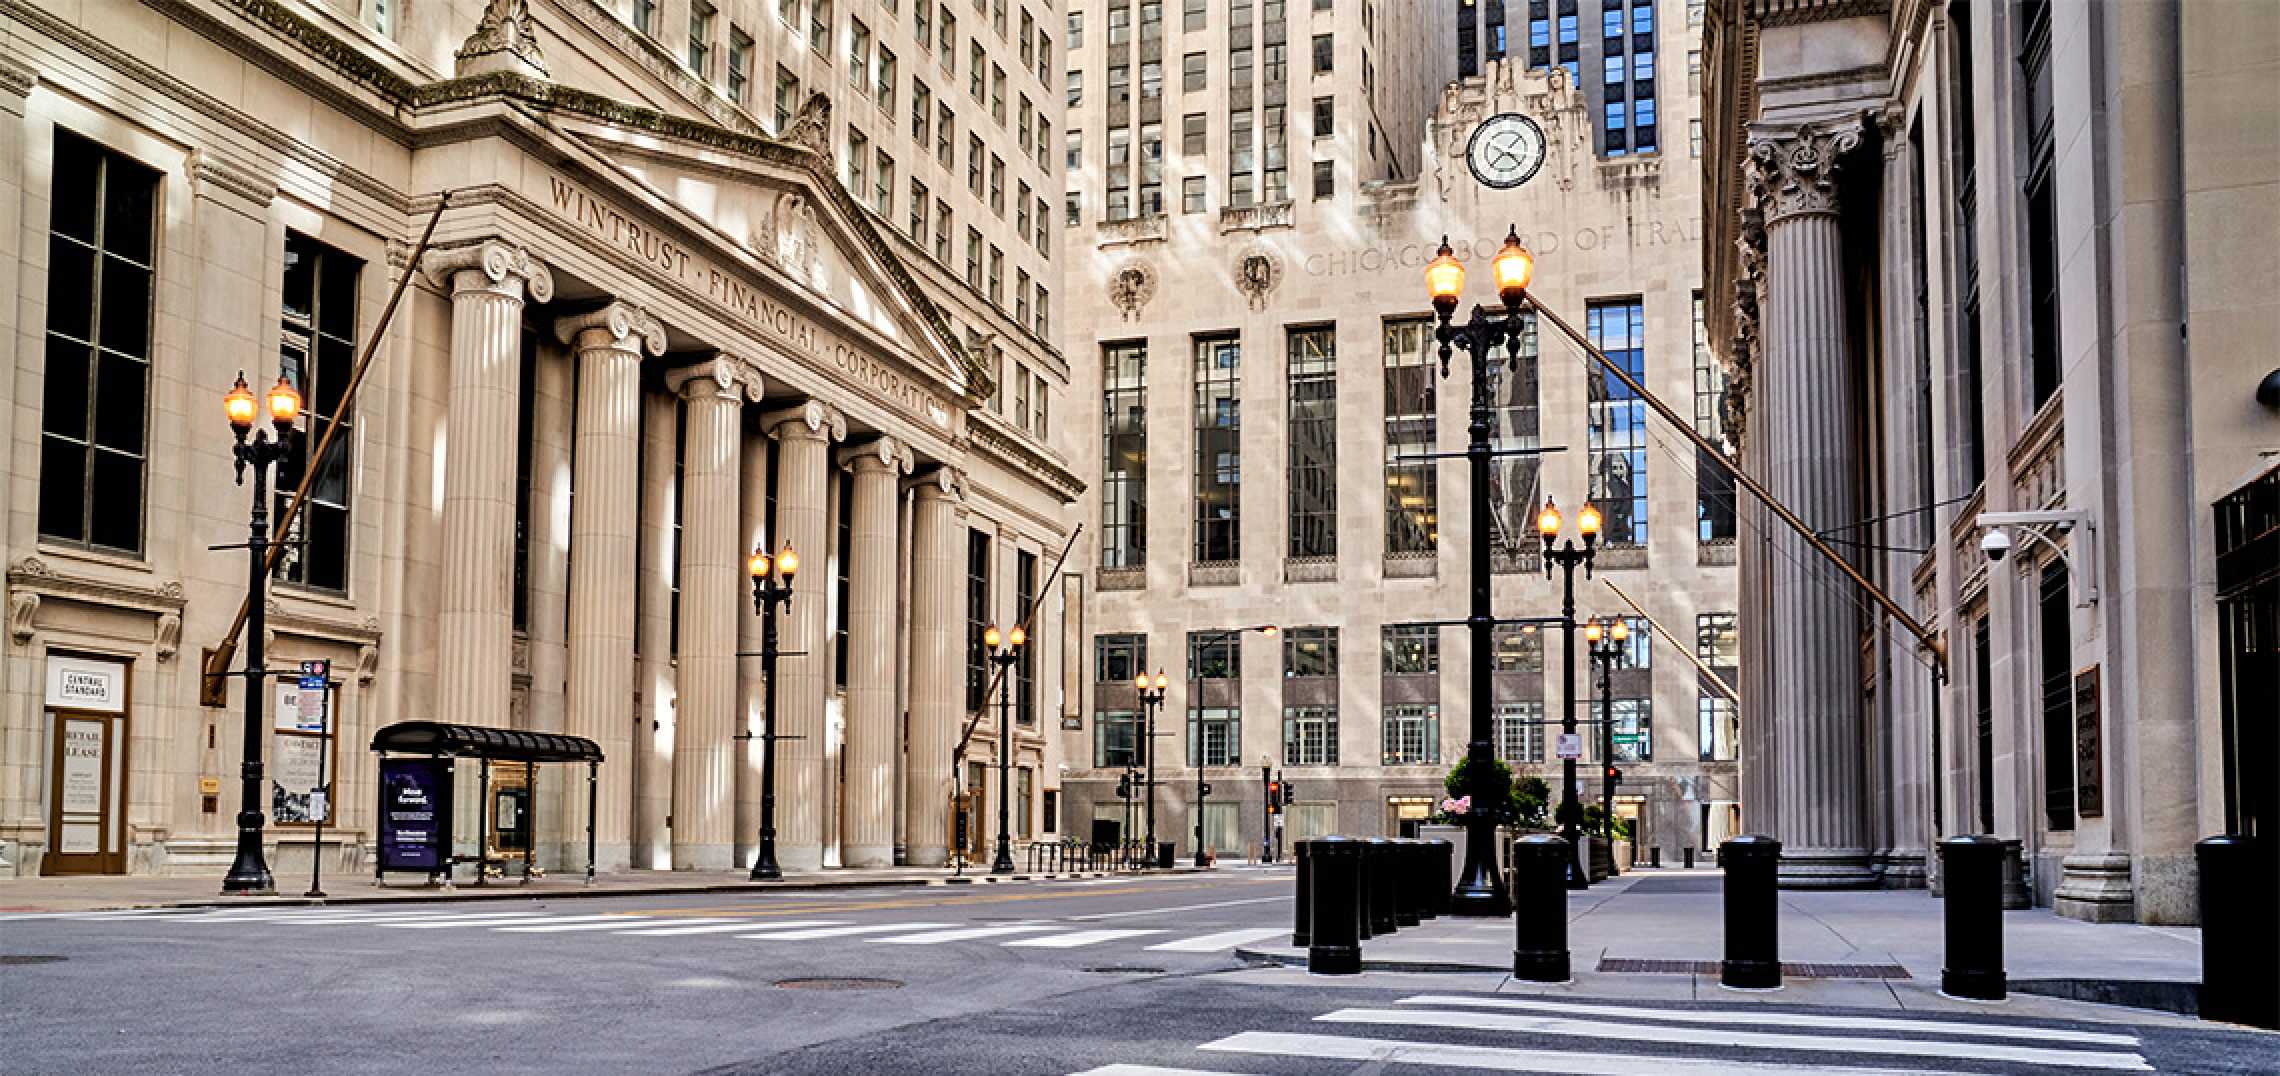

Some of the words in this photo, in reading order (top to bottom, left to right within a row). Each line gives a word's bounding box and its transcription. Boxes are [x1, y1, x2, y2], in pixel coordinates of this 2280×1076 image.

[549, 175, 690, 278] WINTRUST
[709, 269, 821, 354] FINANCIAL
[1305, 243, 1443, 277] CHICAGO
[1454, 231, 1558, 263] BORD
[1575, 225, 1615, 251] OF
[1629, 217, 1703, 248] TRAD
